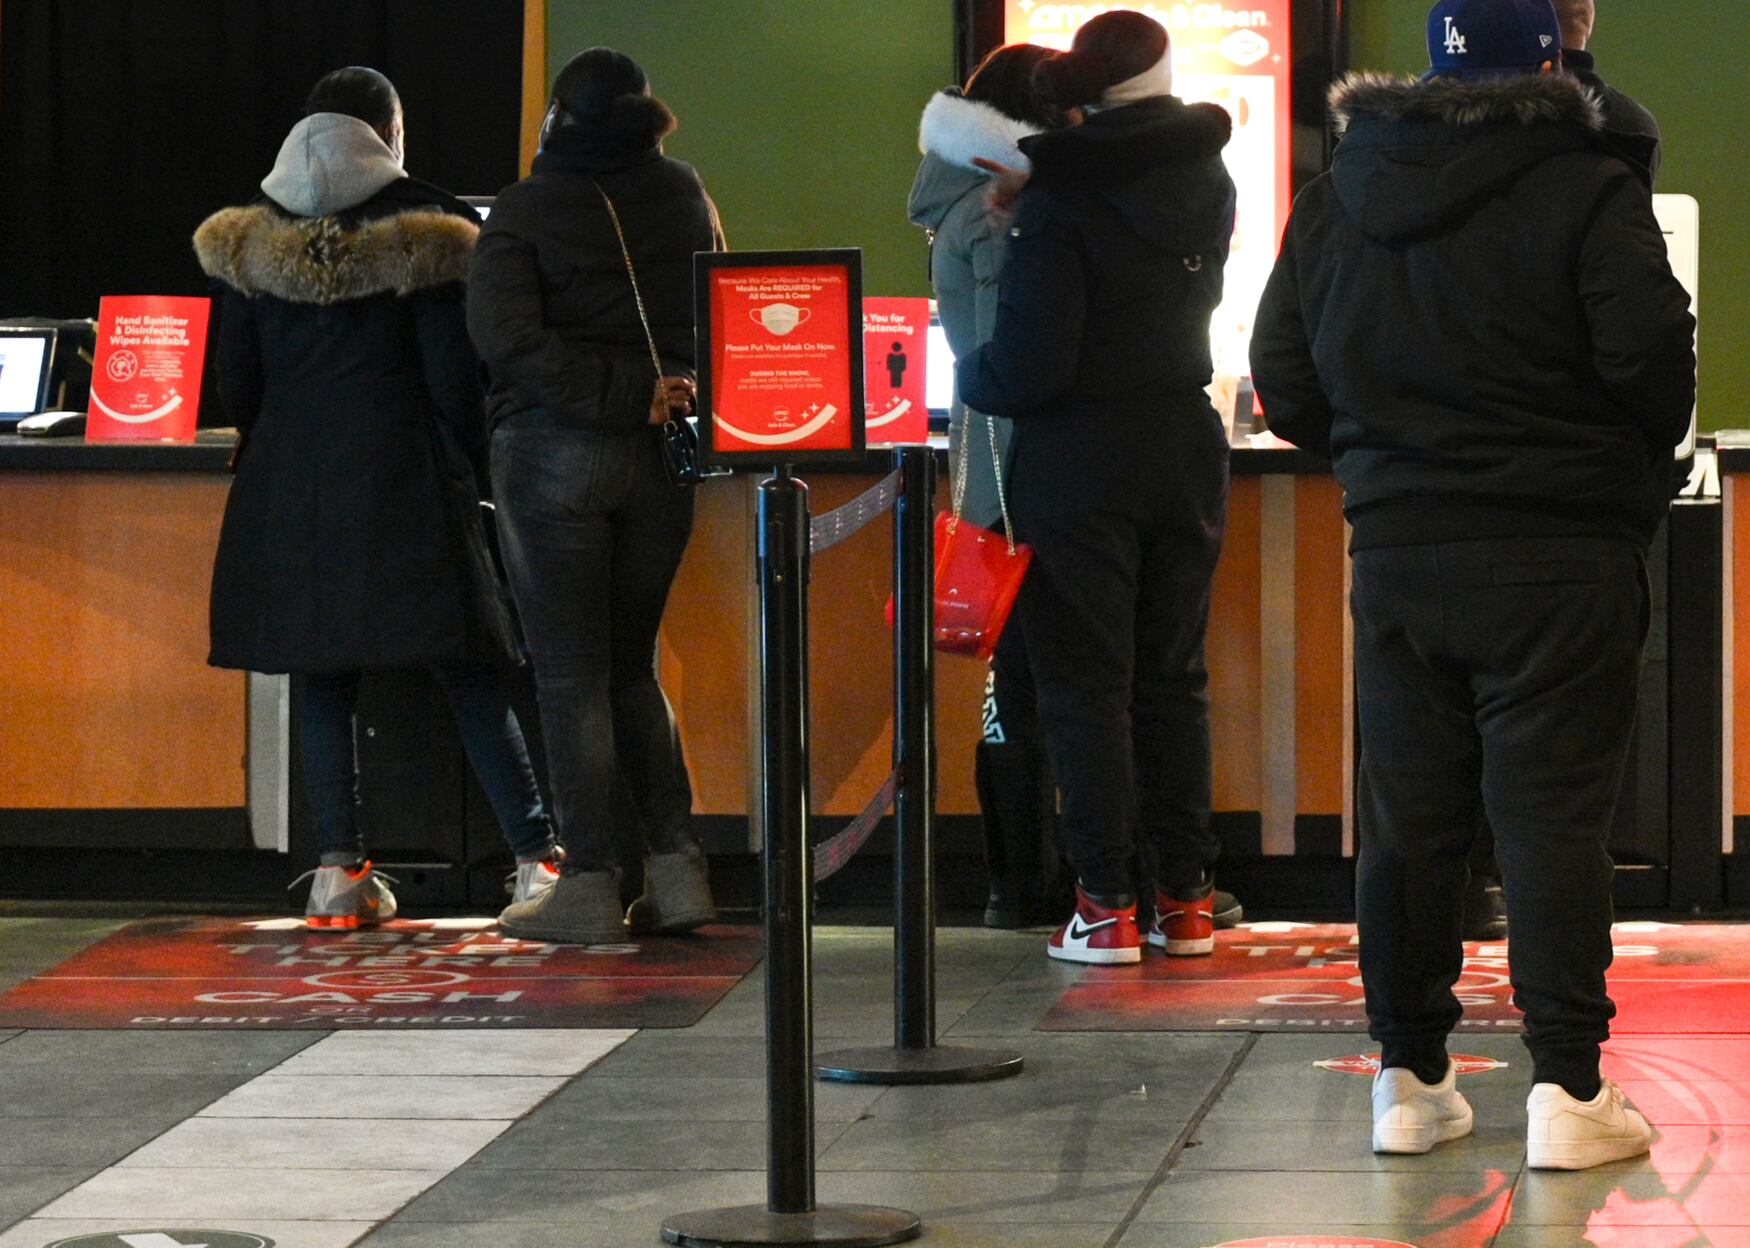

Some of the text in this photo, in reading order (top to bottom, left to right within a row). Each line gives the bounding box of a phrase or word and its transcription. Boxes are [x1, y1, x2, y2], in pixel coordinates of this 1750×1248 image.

[1194, 2, 1266, 28] Clean
[1443, 16, 1467, 54] LA
[773, 284, 811, 292] REQUIRED
[115, 316, 189, 326] Hand Sanitizer
[870, 313, 889, 322] You
[890, 313, 905, 322] for
[115, 326, 187, 337] & Disinfecting
[110, 335, 190, 346] Wipes Available
[725, 344, 749, 352] Please
[751, 343, 763, 351] Put
[764, 343, 781, 351] Your
[783, 343, 802, 351] Mask
[217, 943, 640, 955] TICKETS
[274, 955, 554, 966] HERE
[194, 990, 524, 1004] CASH
[130, 1015, 284, 1024] DEBIT
[333, 1015, 528, 1024] CREDIT
[1215, 1018, 1368, 1026] DEBIT
